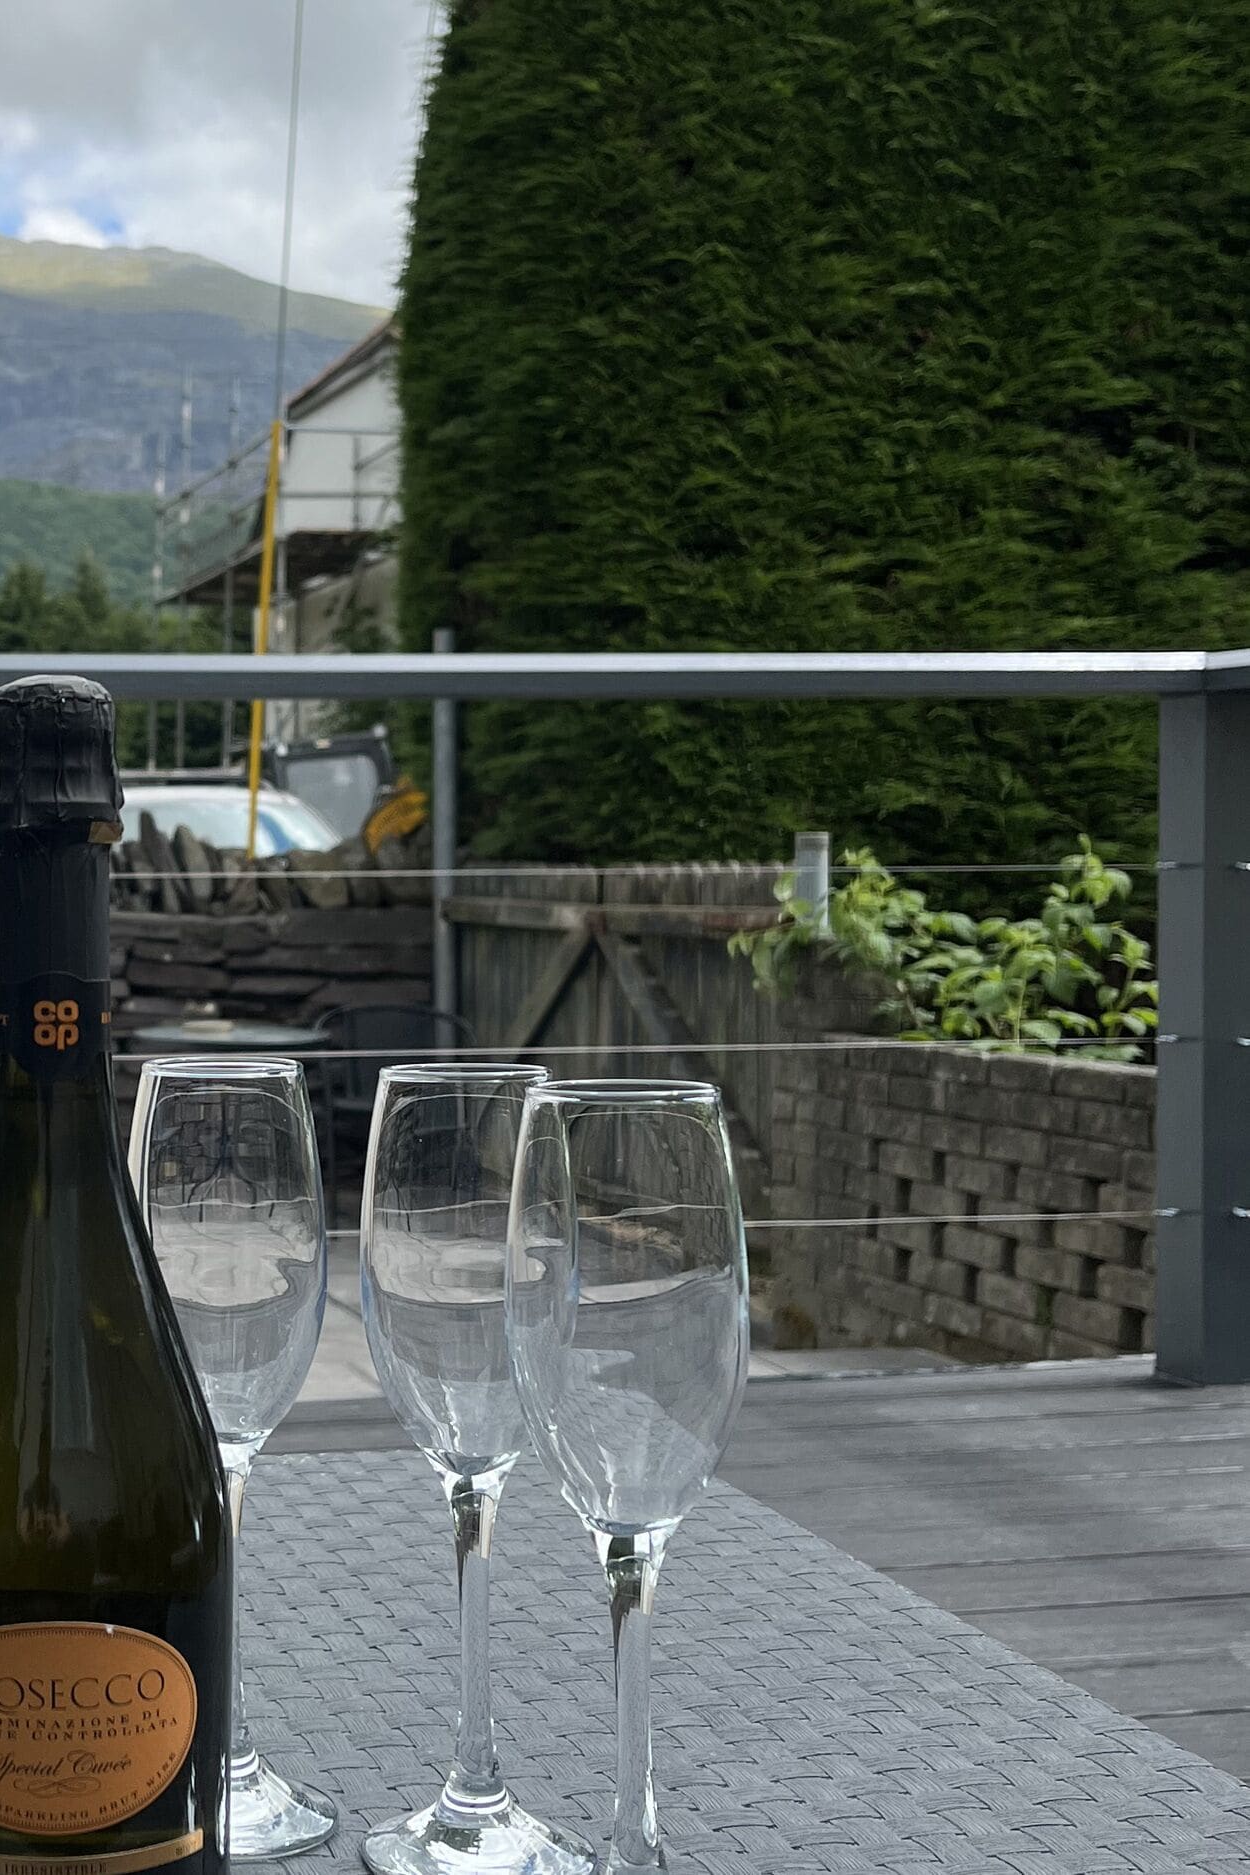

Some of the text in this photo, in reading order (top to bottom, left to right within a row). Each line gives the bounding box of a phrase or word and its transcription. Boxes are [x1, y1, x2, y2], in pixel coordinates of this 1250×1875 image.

[142, 1708, 162, 1722] DI
[31, 1716, 180, 1743] CONTROLLATA
[66, 1749, 133, 1775] Cuvée
[97, 1790, 142, 1820] BRUT
